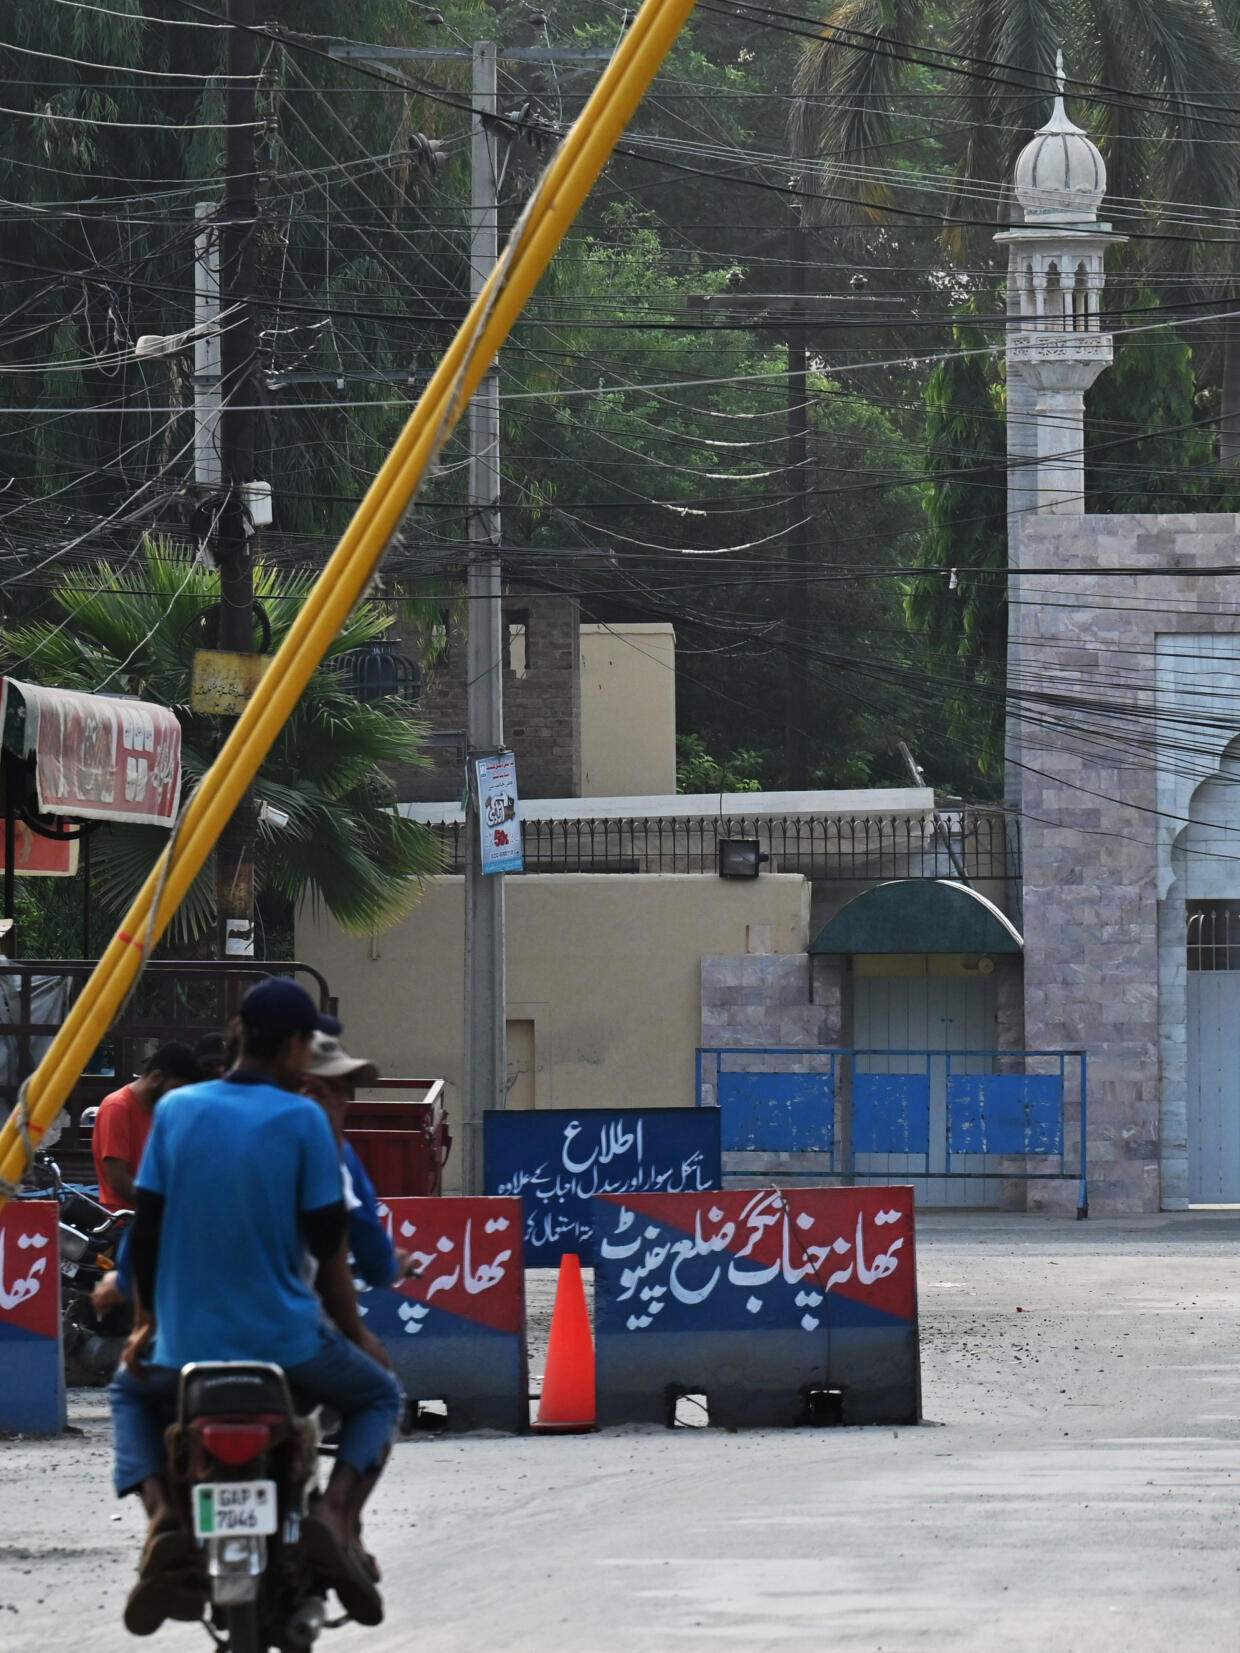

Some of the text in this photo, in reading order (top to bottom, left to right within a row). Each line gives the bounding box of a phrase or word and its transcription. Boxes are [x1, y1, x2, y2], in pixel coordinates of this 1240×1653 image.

[562, 1118, 643, 1173] اطلاع
[536, 1172, 576, 1204] احباب
[426, 1216, 513, 1300] تھانہ
[601, 1205, 672, 1331] چنیوٹ
[670, 1206, 736, 1304] ضلع
[728, 1206, 832, 1331] چناب
[826, 1209, 905, 1293] تھانہ
